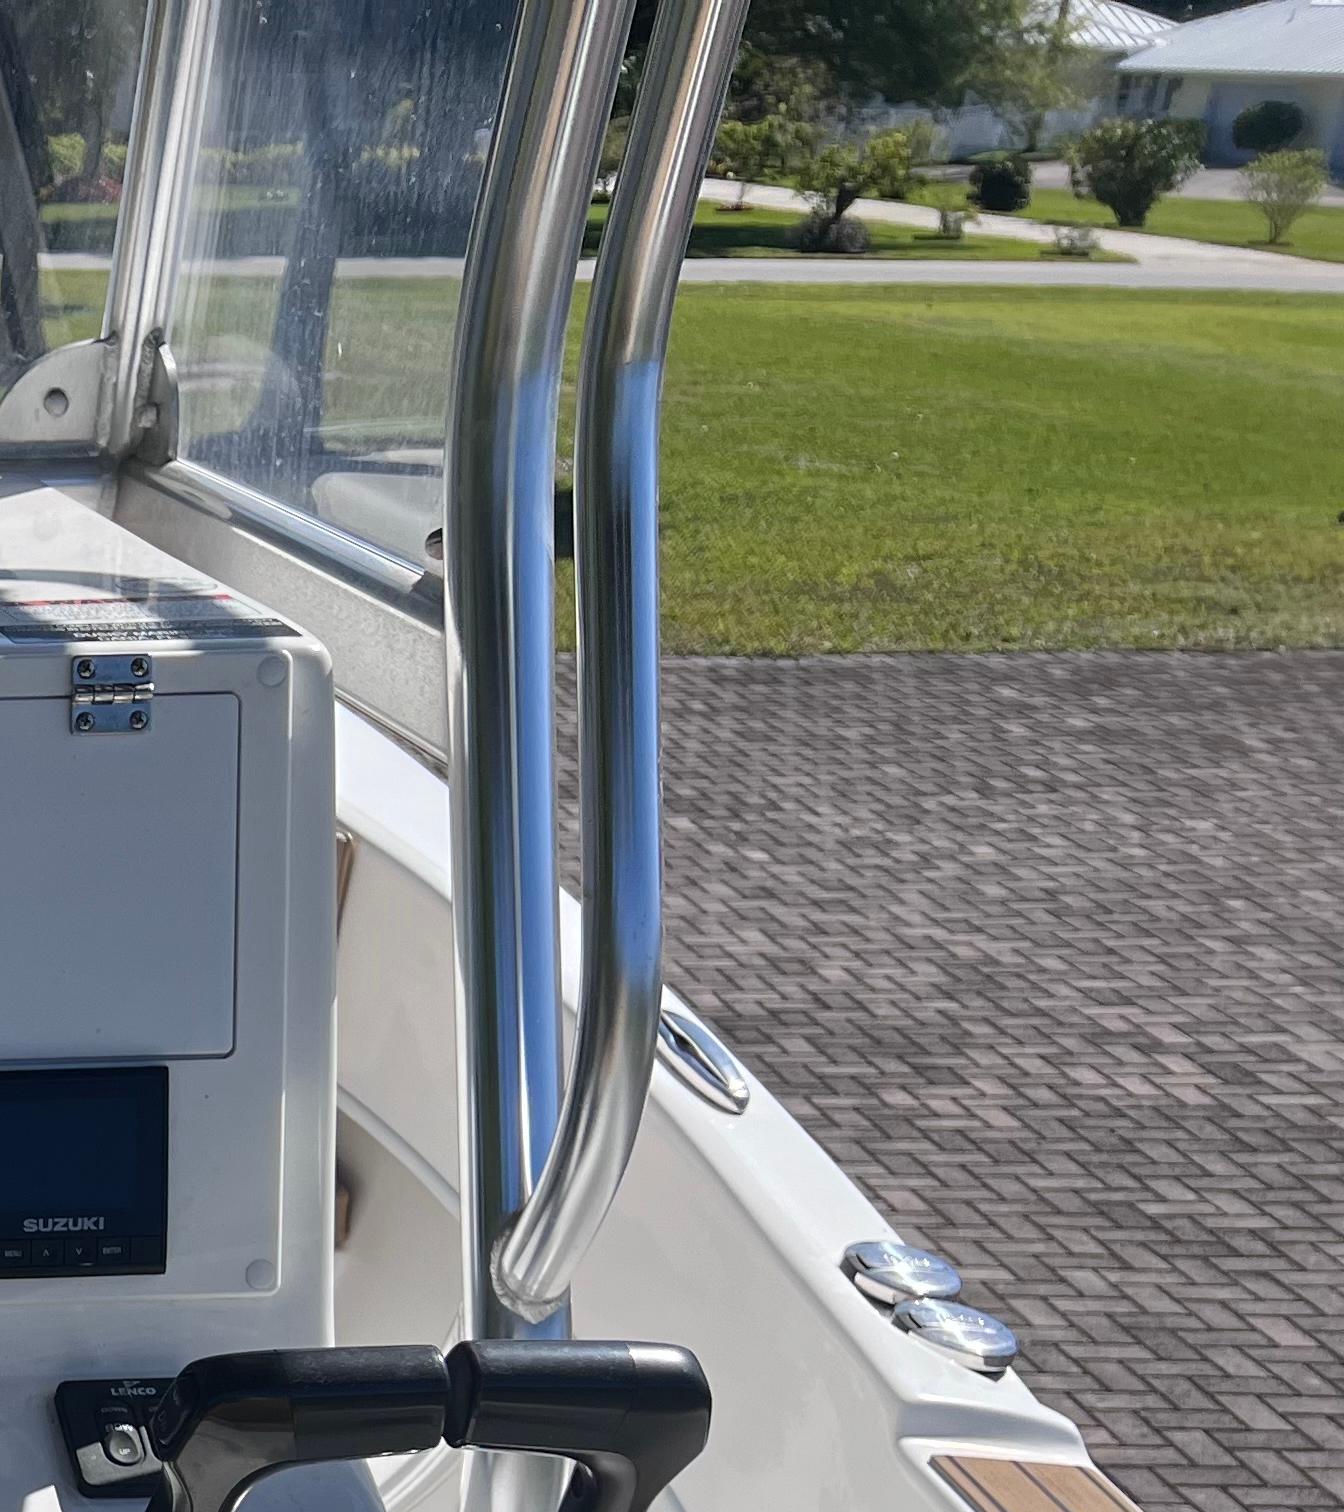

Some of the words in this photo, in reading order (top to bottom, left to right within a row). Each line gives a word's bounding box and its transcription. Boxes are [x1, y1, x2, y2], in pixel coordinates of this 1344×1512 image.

[22, 1216, 105, 1232] SUZUKI
[110, 1386, 157, 1398] LENCO
[119, 1448, 131, 1456] UP
